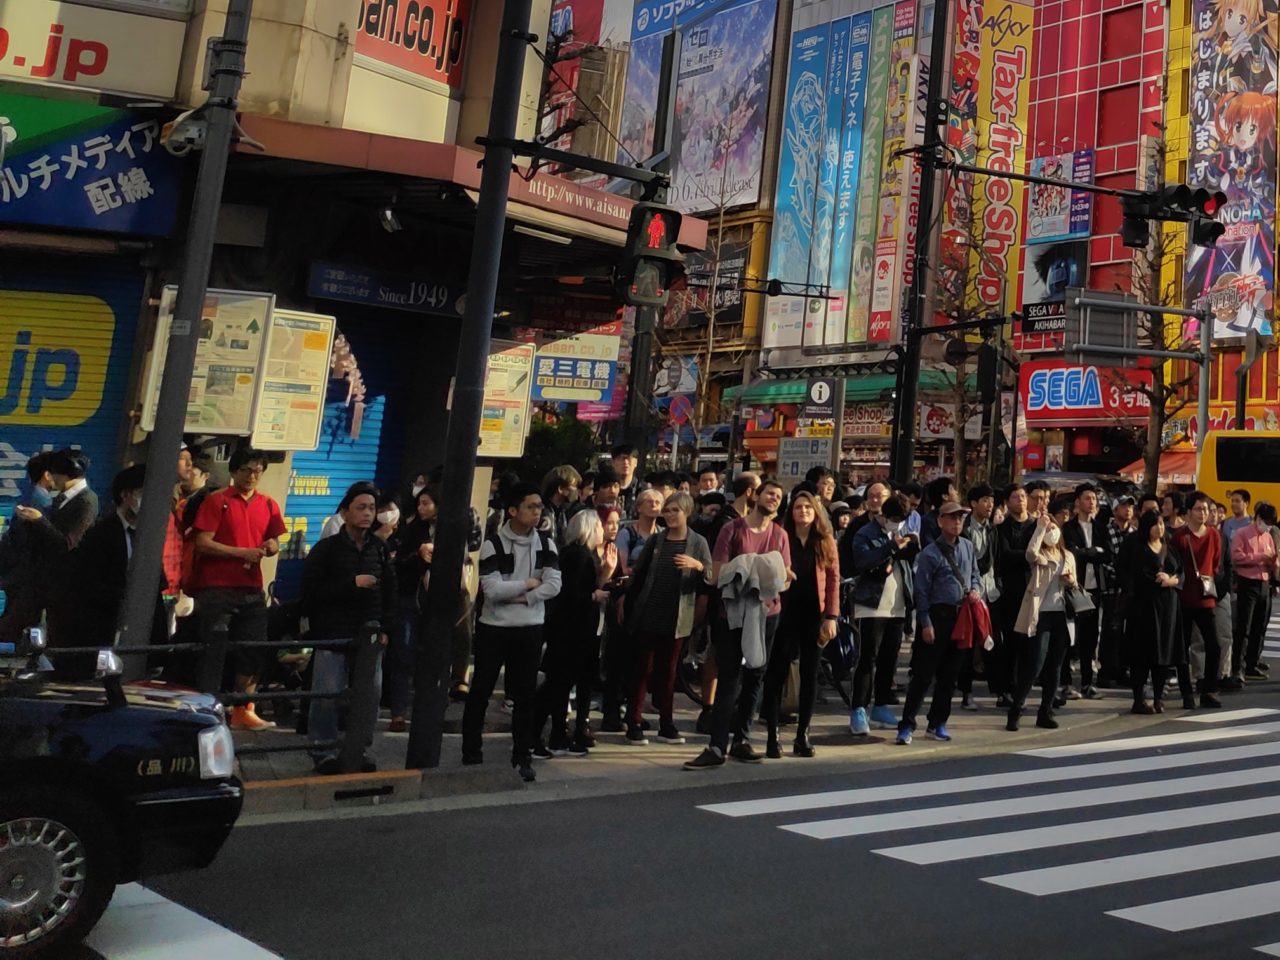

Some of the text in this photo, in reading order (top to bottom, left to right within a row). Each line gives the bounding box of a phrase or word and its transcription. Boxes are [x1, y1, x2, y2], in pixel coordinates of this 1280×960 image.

[83, 166, 155, 216] 配線
[377, 280, 449, 309] Since 1949
[1028, 306, 1047, 317] SEGA
[0, 330, 82, 415] jp
[538, 358, 611, 379] 愛三電機
[1027, 366, 1104, 411] SEGA
[857, 406, 882, 424] Shop
